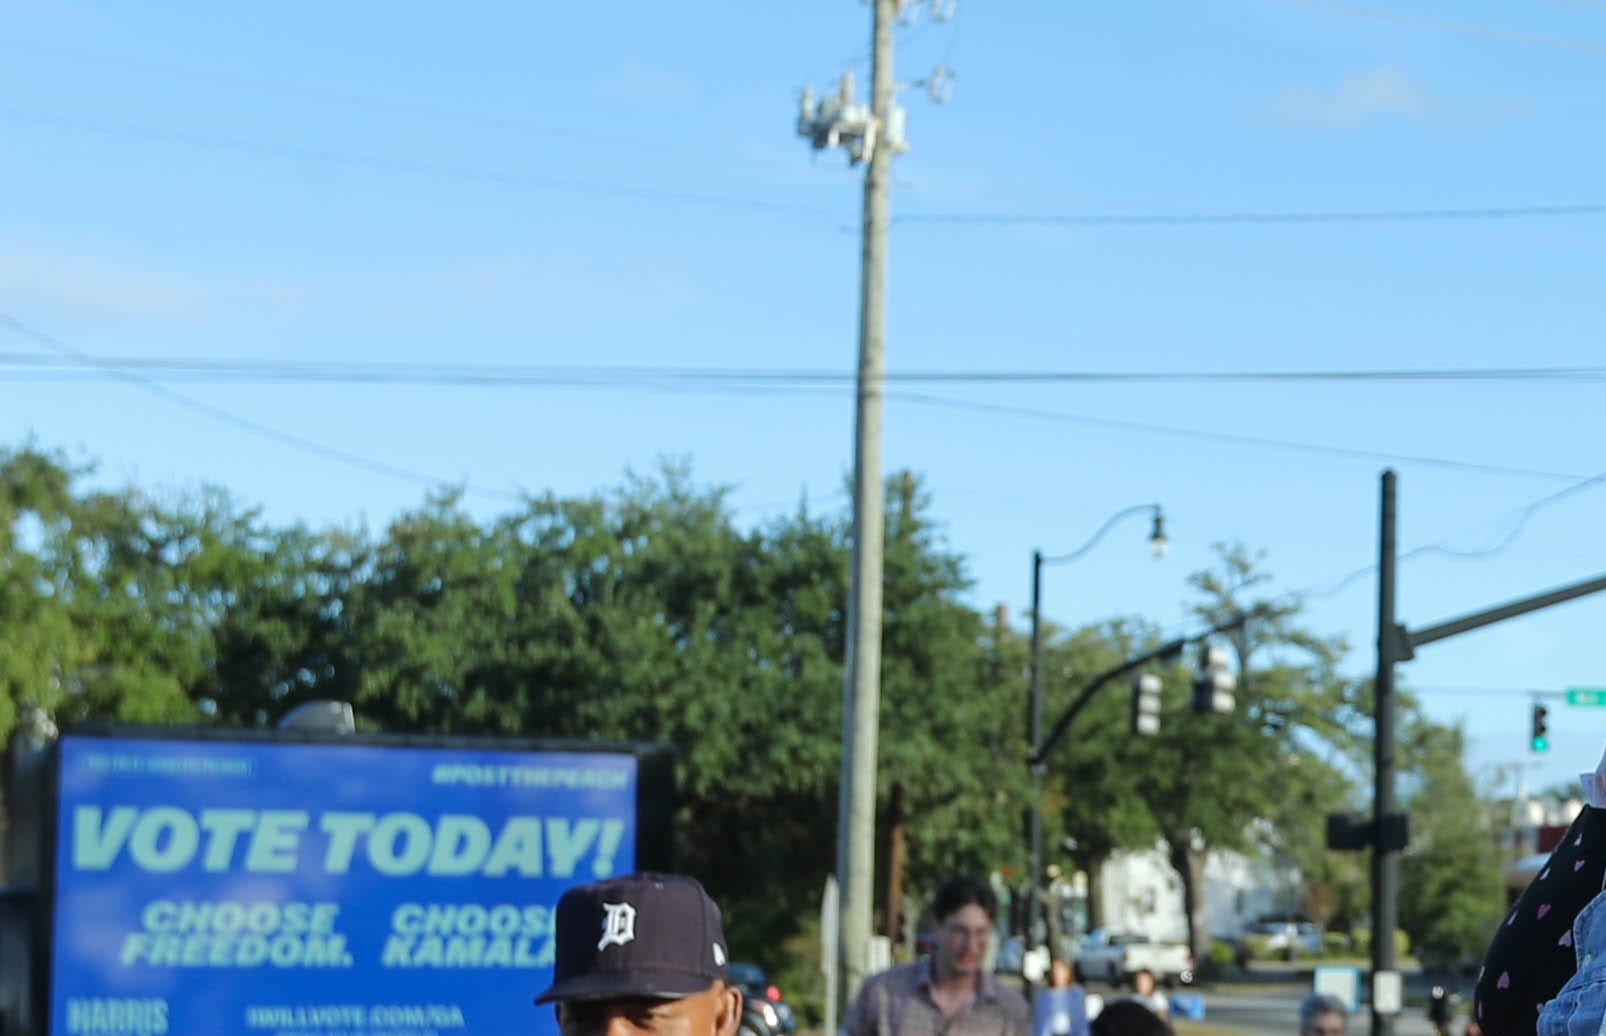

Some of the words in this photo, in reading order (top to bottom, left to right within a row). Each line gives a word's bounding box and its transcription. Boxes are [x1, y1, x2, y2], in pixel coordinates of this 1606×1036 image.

[72, 804, 309, 873] VOTE
[320, 811, 624, 879] TODAY!
[143, 901, 341, 937] CHOOSE
[598, 901, 637, 951] D
[121, 932, 354, 968] FREEDOM.
